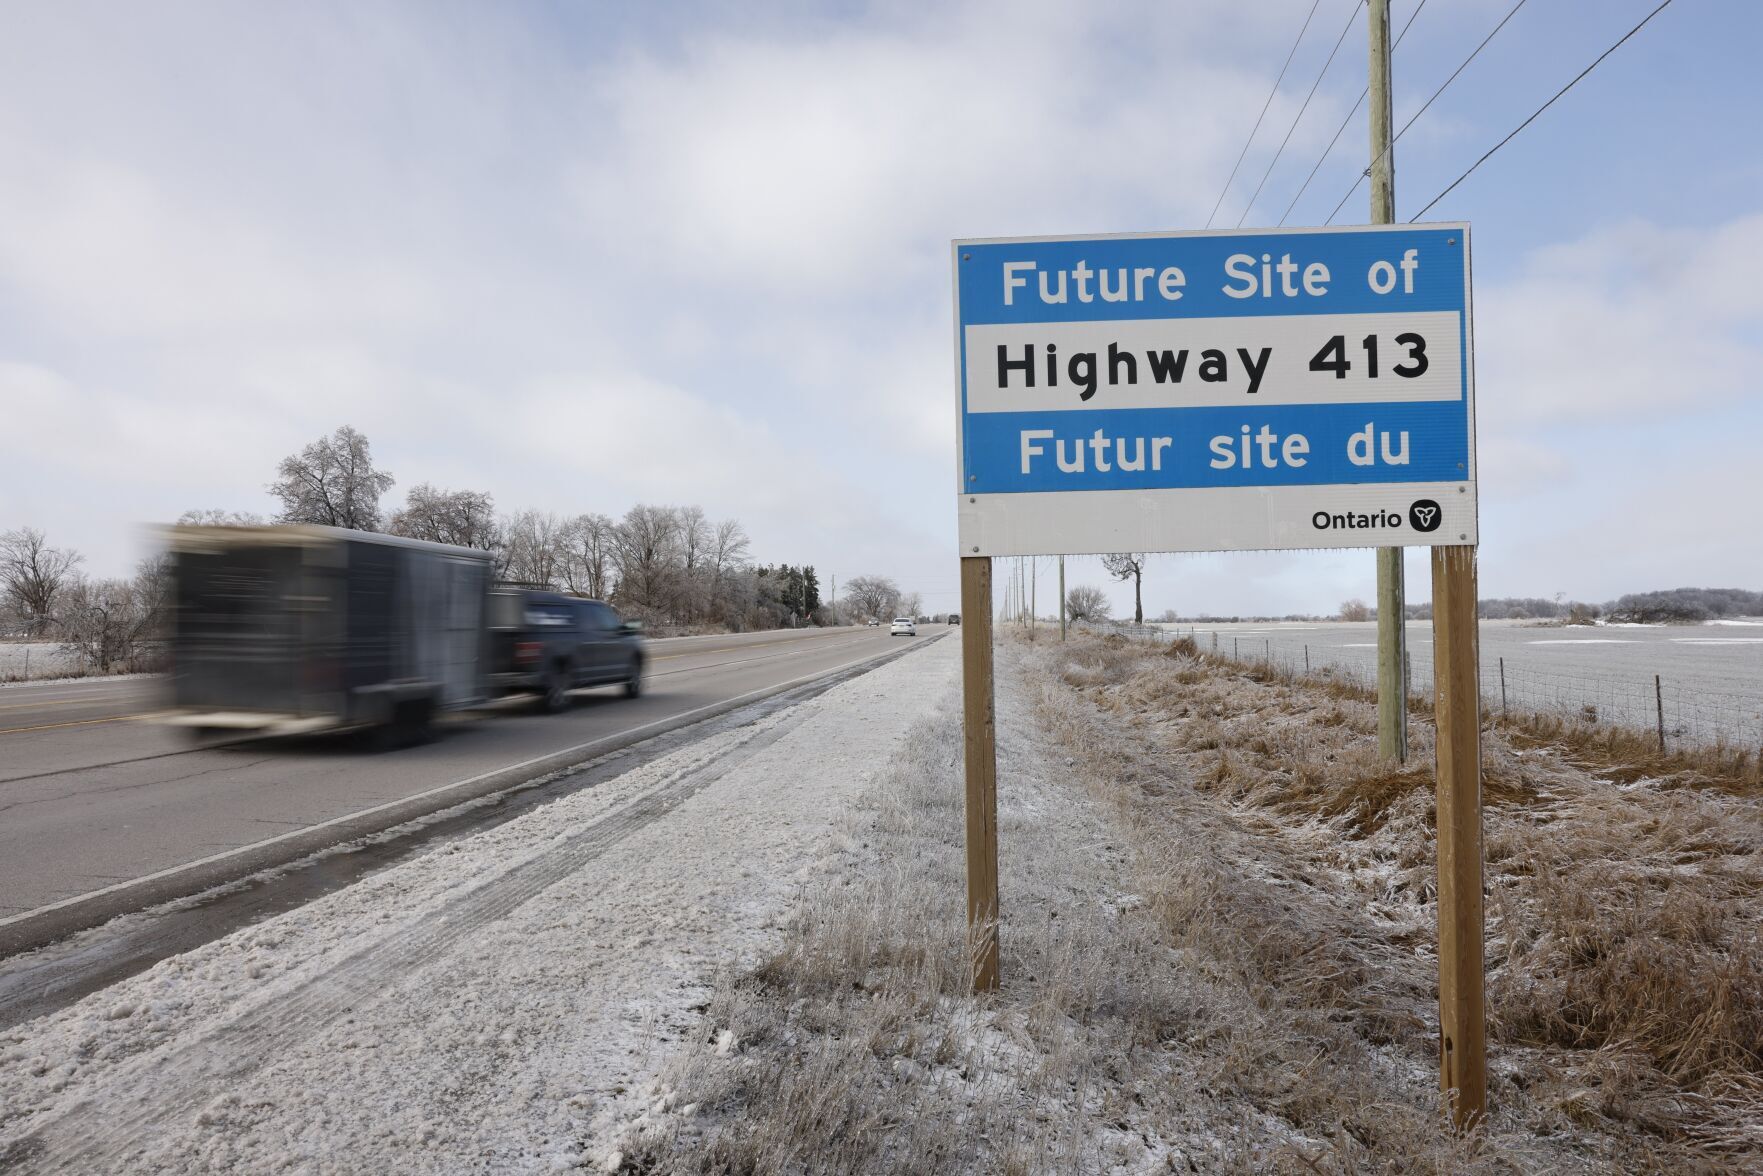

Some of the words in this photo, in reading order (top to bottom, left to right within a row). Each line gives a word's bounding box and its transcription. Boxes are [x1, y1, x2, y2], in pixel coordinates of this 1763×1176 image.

[1002, 259, 1187, 306] Future
[1221, 252, 1331, 299] Site
[1367, 248, 1420, 295] of
[997, 341, 1273, 402] Highway
[1308, 332, 1429, 380] 413
[1020, 428, 1173, 475] Futur
[1209, 424, 1311, 470] site
[1346, 422, 1410, 466] du
[1312, 509, 1402, 530] Ontario
